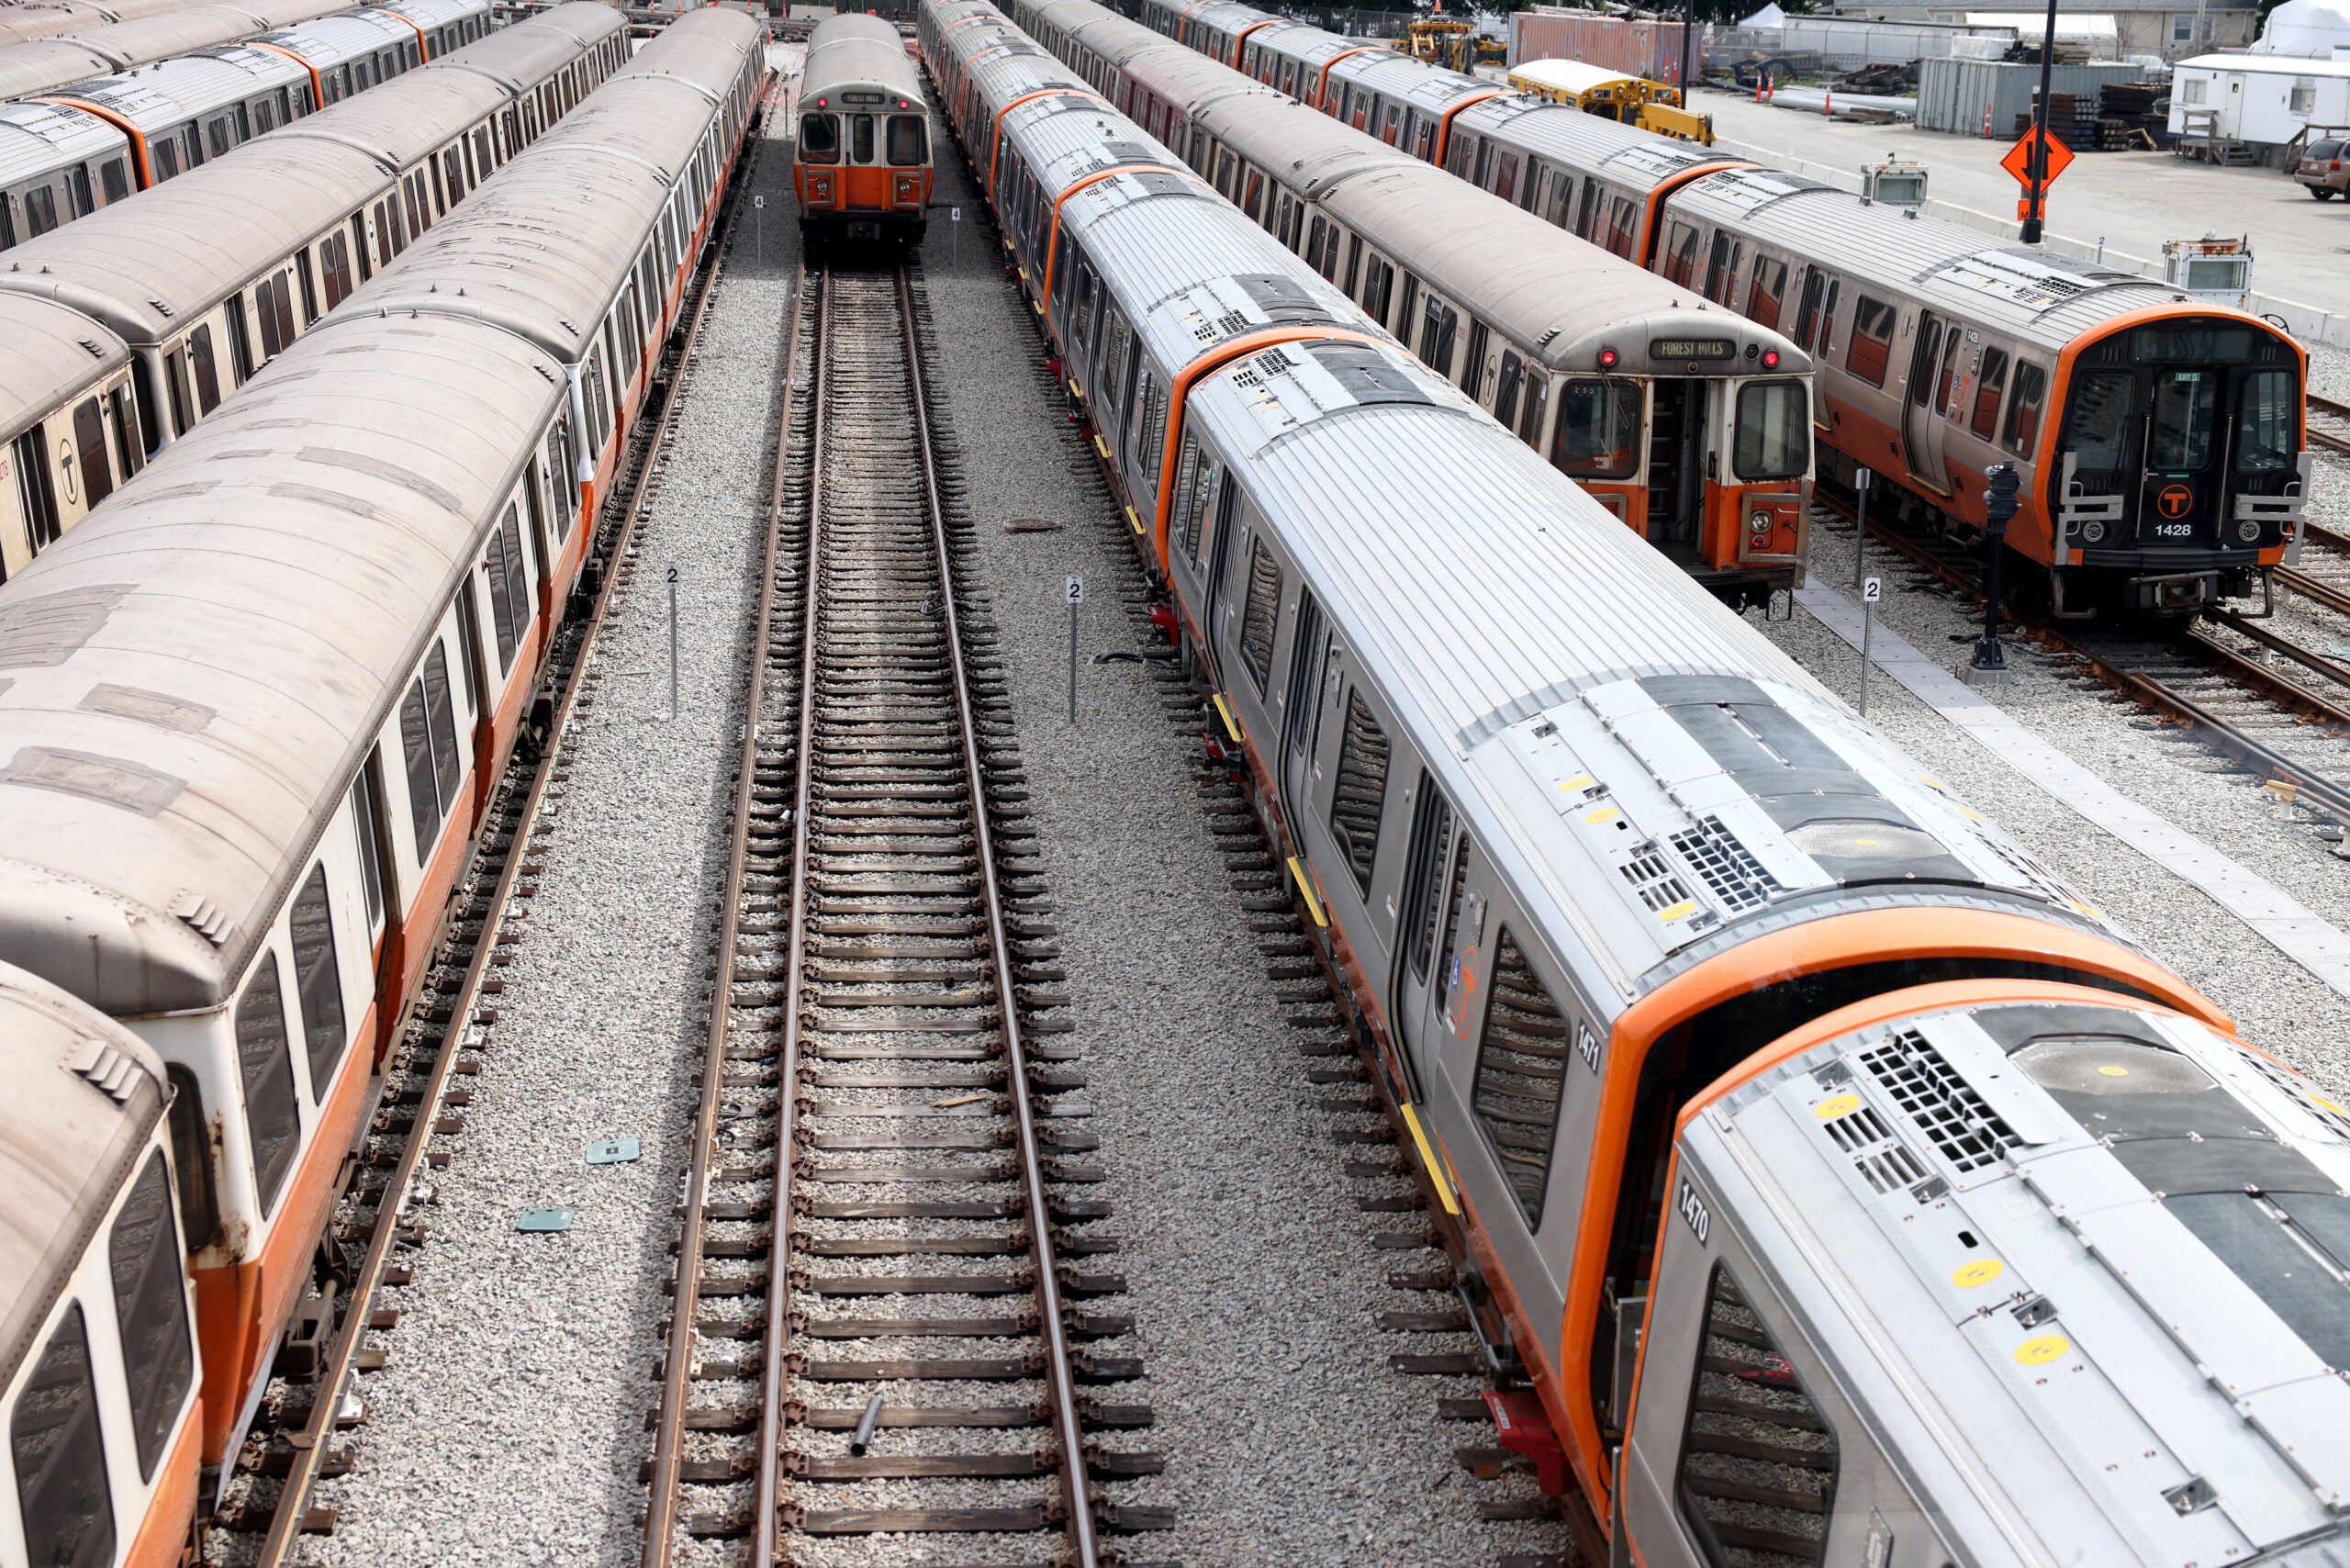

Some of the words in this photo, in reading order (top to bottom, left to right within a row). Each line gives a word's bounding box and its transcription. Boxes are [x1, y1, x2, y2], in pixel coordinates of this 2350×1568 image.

[1662, 342, 1694, 355] FOREST
[1698, 342, 1723, 355] HILLS
[2165, 493, 2188, 513] T
[2155, 524, 2191, 536] 1428
[667, 568, 678, 583] 2
[1069, 583, 1080, 598] 2
[1867, 581, 1878, 597] 2
[1579, 1024, 1600, 1072] 1471
[1682, 1182, 1708, 1242] 1470
